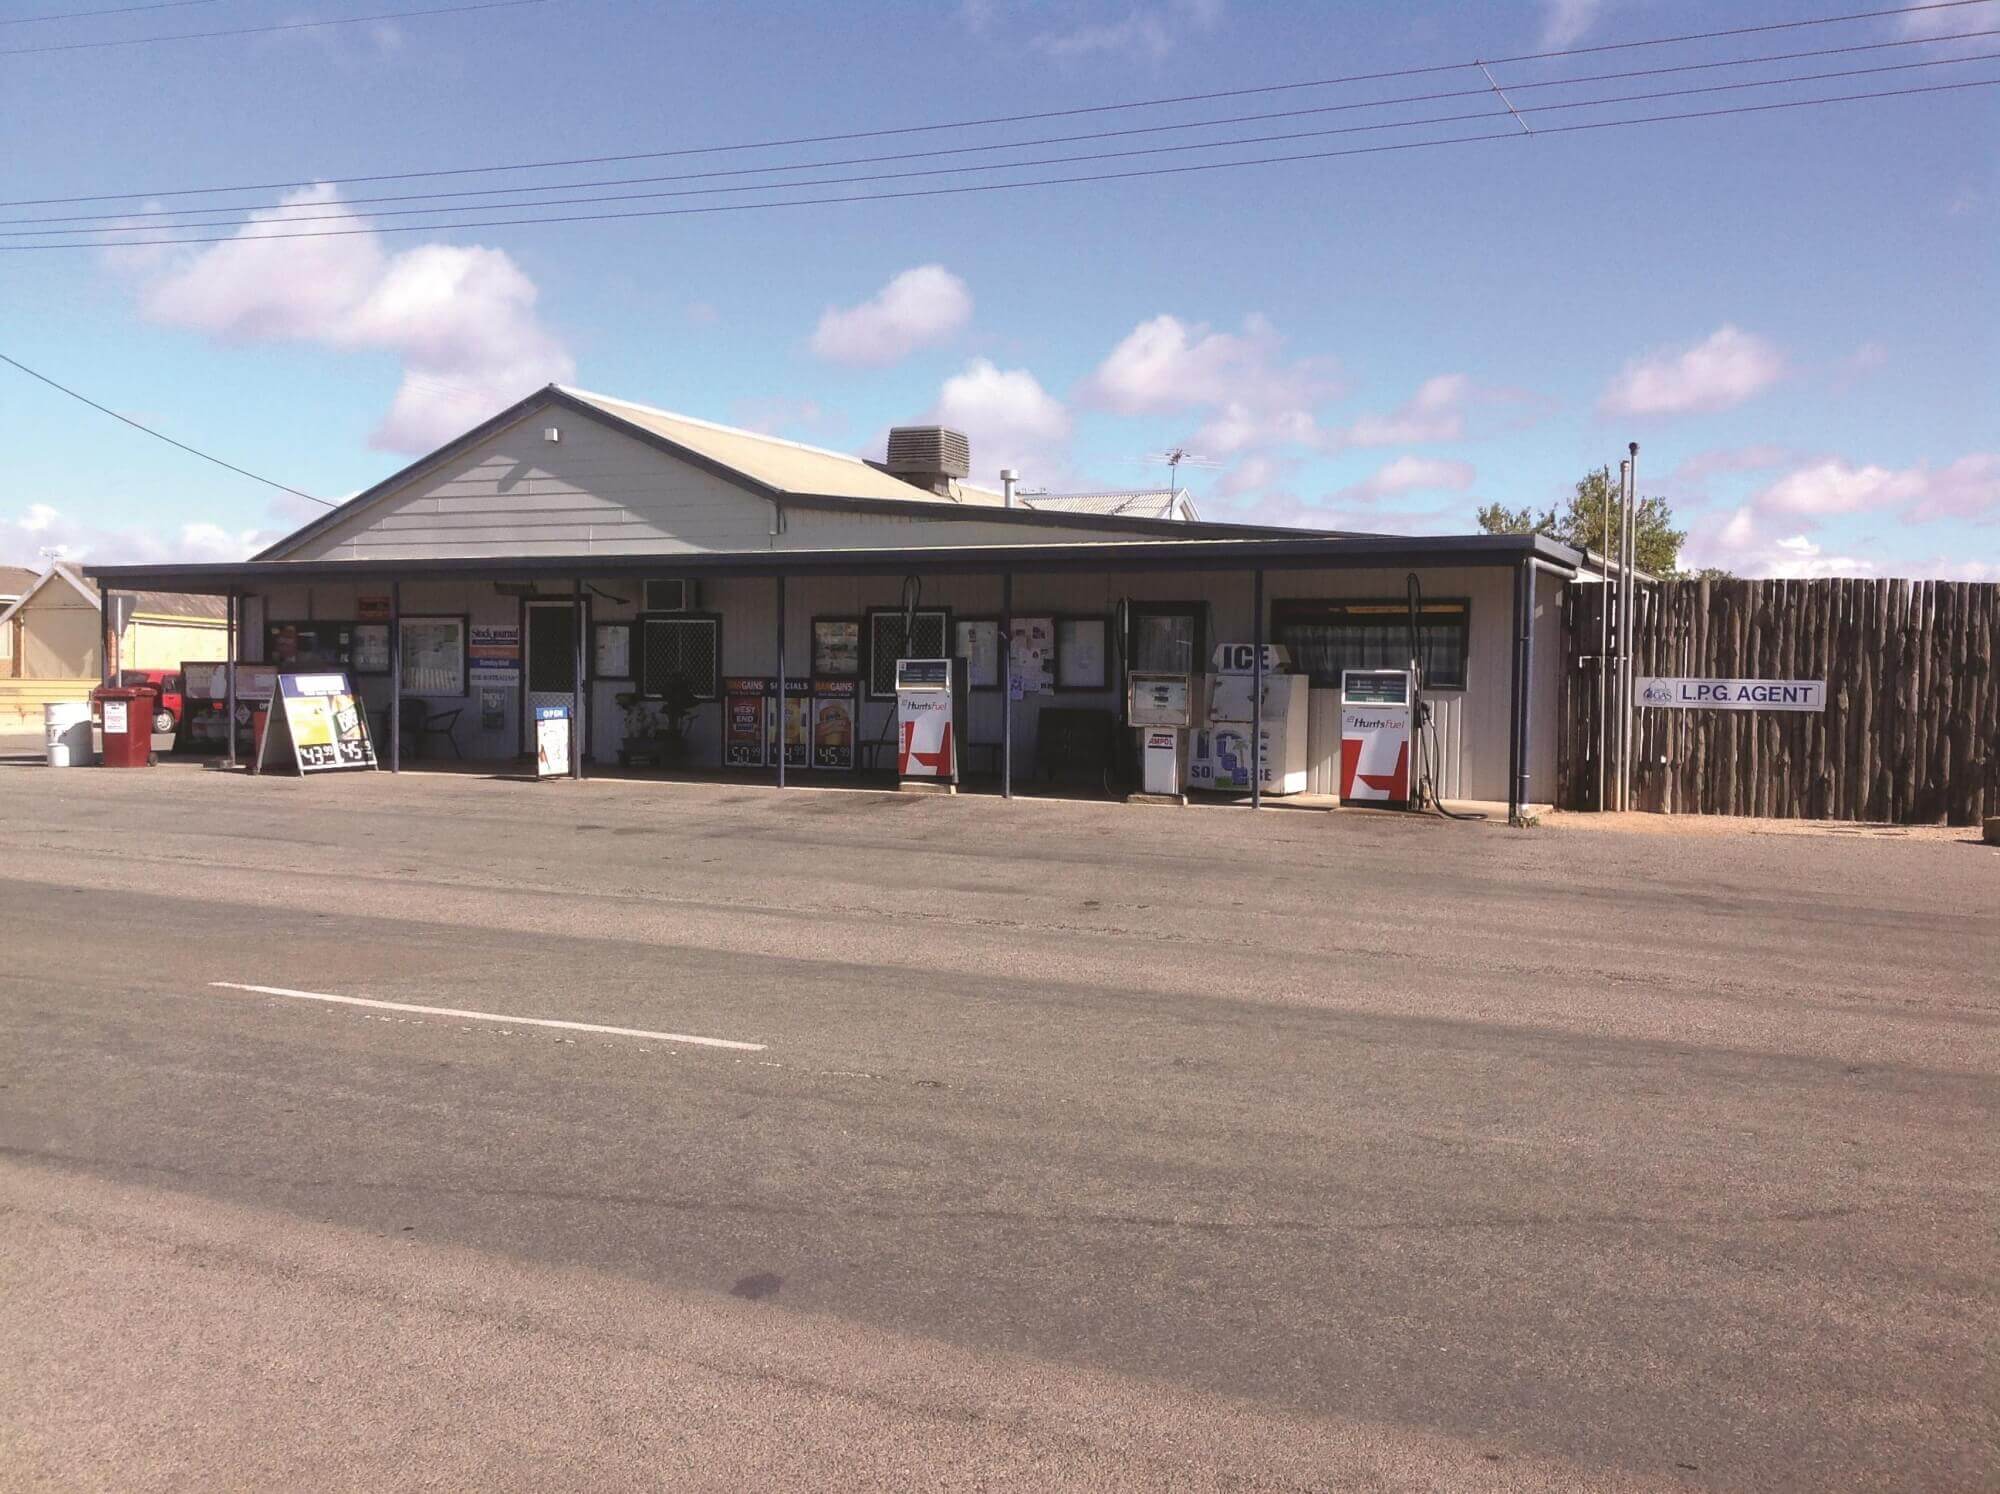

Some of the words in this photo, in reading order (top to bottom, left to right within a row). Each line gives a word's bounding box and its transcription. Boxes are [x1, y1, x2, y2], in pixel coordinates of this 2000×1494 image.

[1223, 646, 1269, 669] ICE
[769, 681, 808, 690] SCIALS
[1682, 685, 1731, 701] L.P.G.
[1736, 686, 1813, 703] AGENT
[542, 710, 563, 719] OPEN
[1149, 737, 1173, 745] AMPOL
